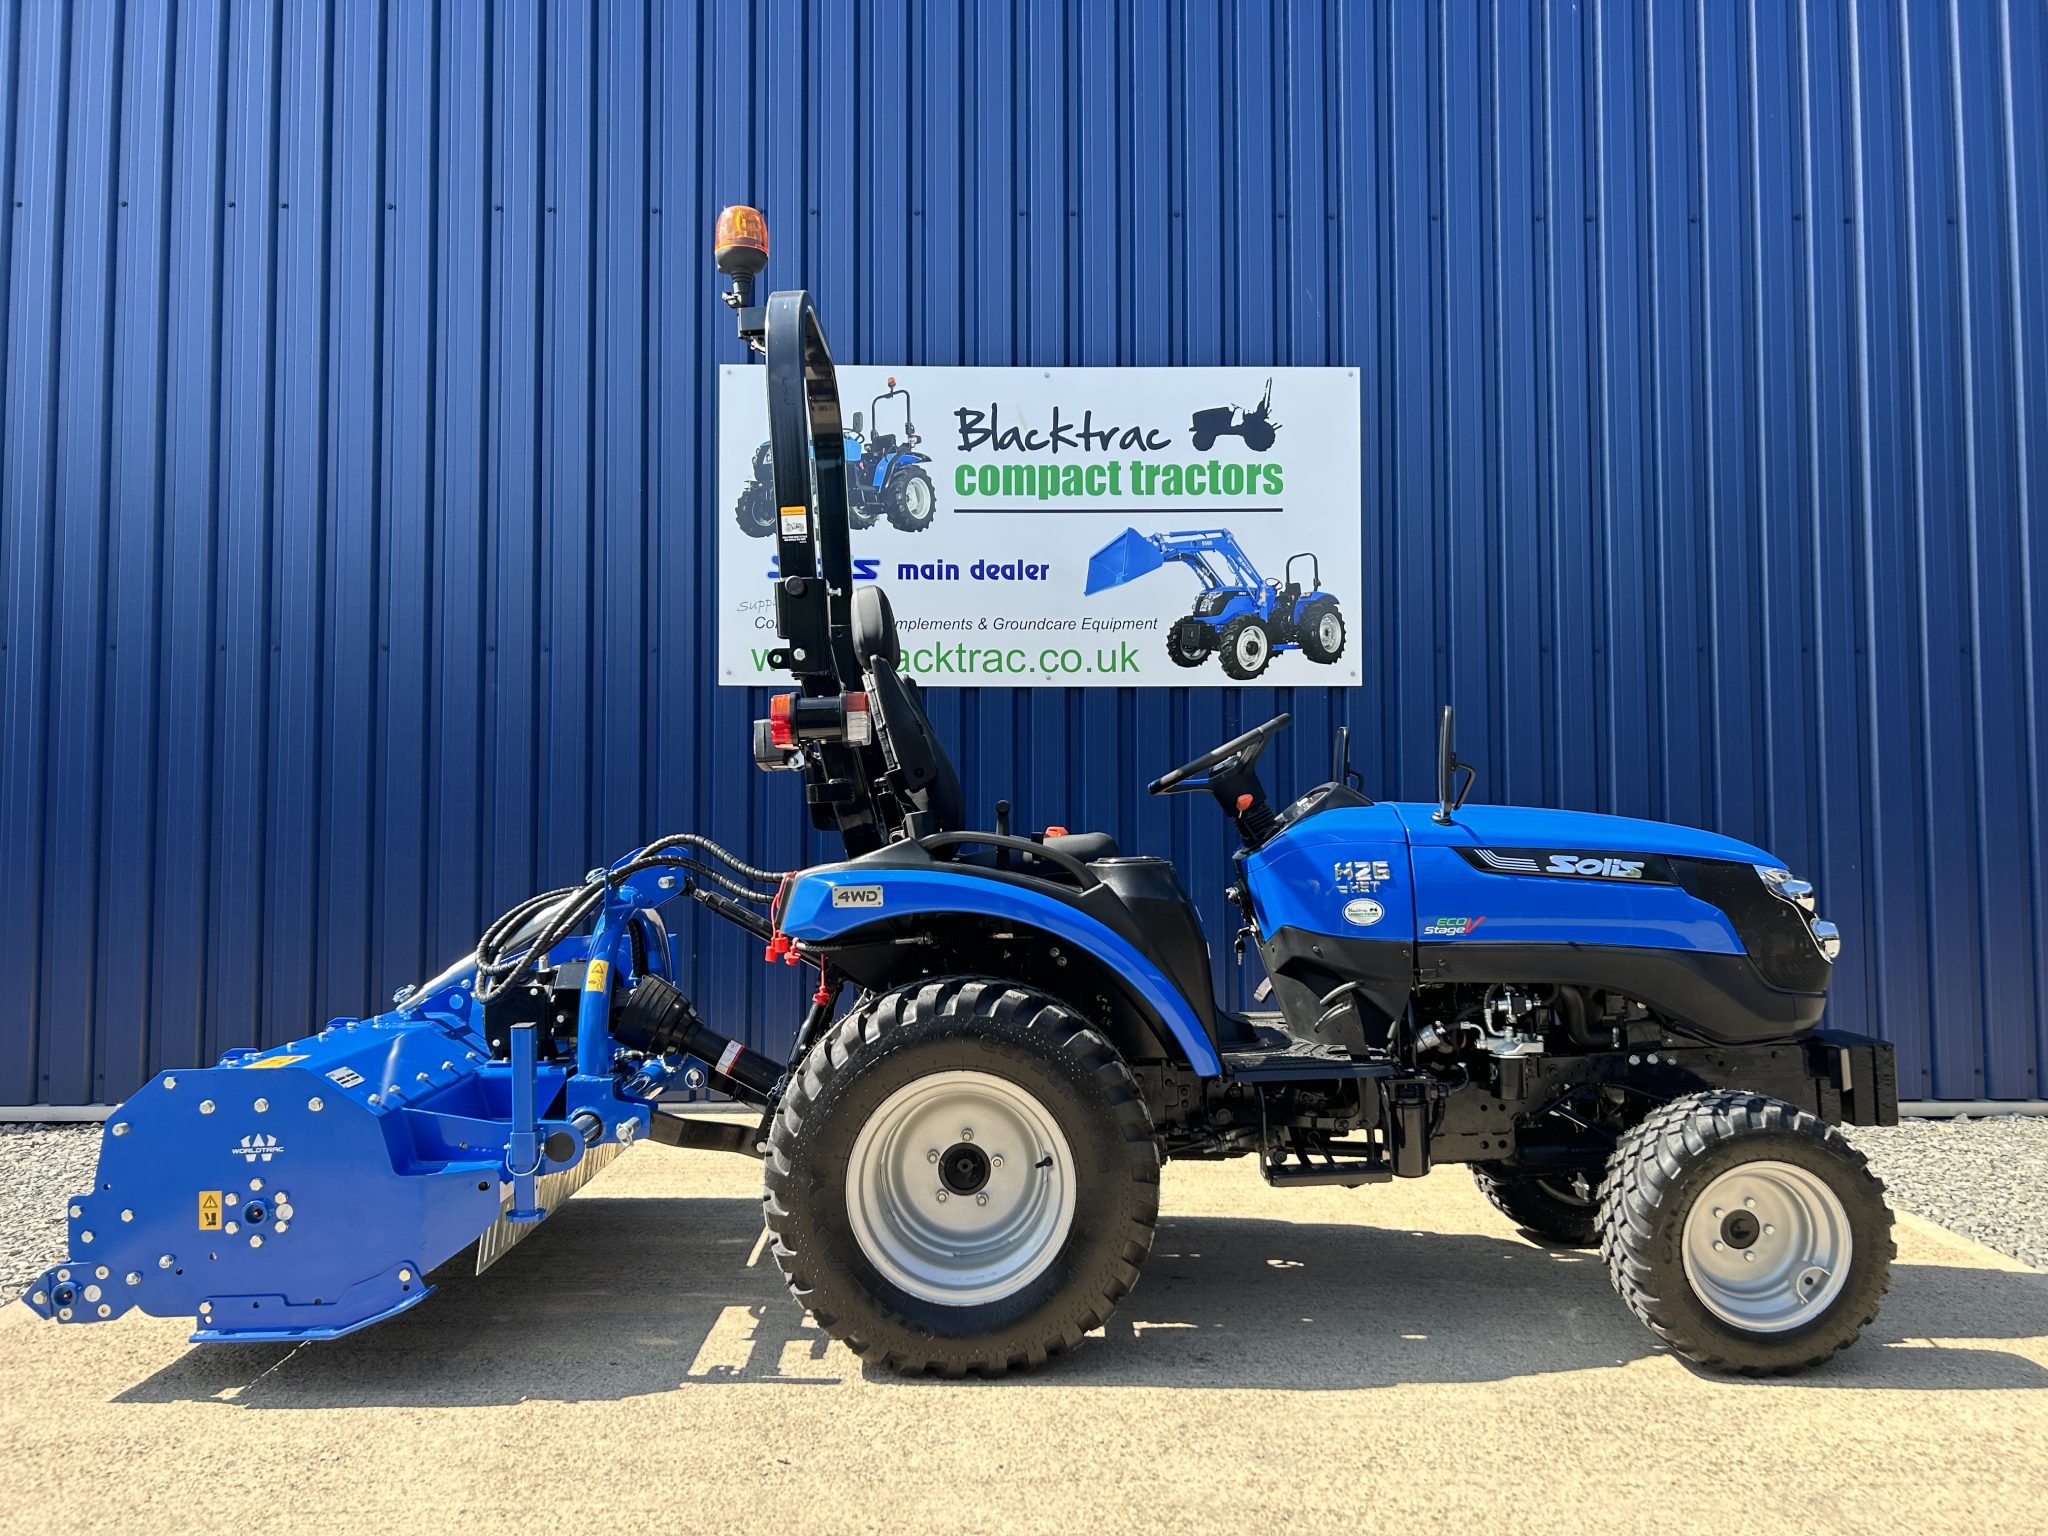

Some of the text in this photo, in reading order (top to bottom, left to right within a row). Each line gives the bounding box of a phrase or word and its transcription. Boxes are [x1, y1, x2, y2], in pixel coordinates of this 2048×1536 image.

[954, 402, 1171, 453] Blacktrac
[955, 460, 1283, 500] compact tractors
[898, 559, 960, 580] main
[970, 559, 1050, 581] dealer
[895, 617, 1159, 632] mplements & Groundcare Equipment
[838, 890, 878, 903] 4WD
[1436, 917, 1468, 926] ECO
[231, 1146, 285, 1155] WORLDTRAC
